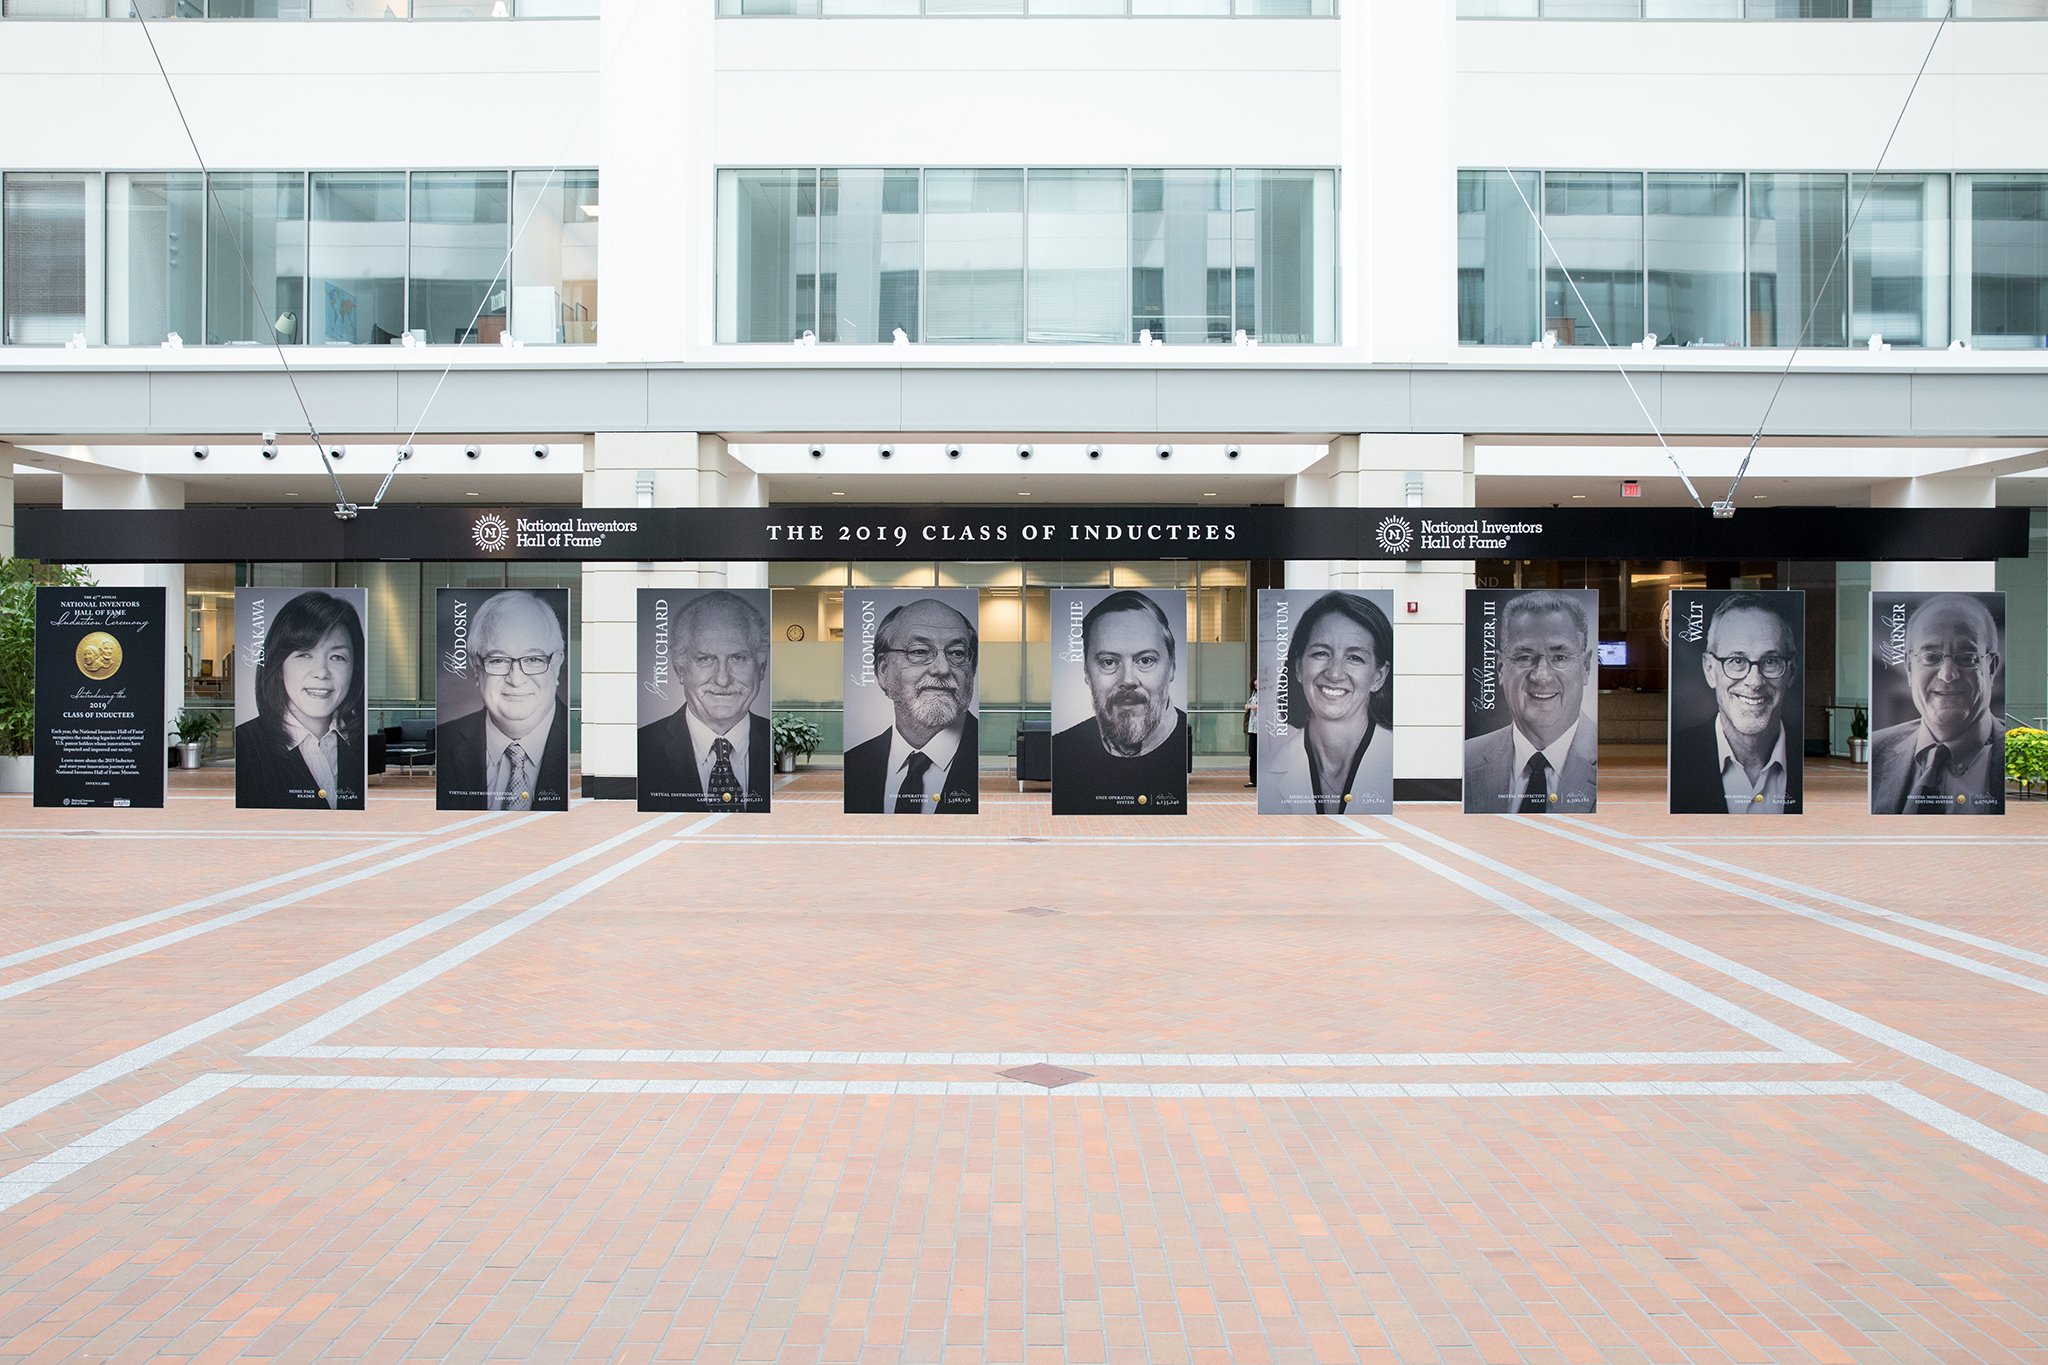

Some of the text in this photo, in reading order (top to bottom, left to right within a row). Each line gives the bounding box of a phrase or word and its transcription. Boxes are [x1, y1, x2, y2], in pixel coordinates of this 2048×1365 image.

[1625, 484, 1638, 495] EXIT
[516, 518, 638, 532] National Inventors
[516, 534, 546, 547] Hall
[548, 534, 561, 547] of
[766, 525, 1236, 547] THE 2019 CLASS OF INDUCTEES
[1421, 520, 1542, 534] National Inventors
[1420, 536, 1450, 549] Hall
[1452, 536, 1466, 549] of
[50, 612, 149, 632] Induction Ceremony
[252, 598, 265, 668] ASAKAWA
[454, 599, 467, 670] KODOSKY
[1071, 601, 1083, 662] RITCHIE
[1690, 601, 1703, 642] WALT
[1893, 603, 1905, 665] WARNER
[656, 599, 668, 684] TRUCHARD
[862, 601, 875, 684] THOMPSON
[1484, 601, 1498, 710] SCHWEITZER, III
[1277, 602, 1288, 736] RICHARDS-KORTUM
[70, 686, 114, 704] Introducing
[90, 702, 106, 710] 2019
